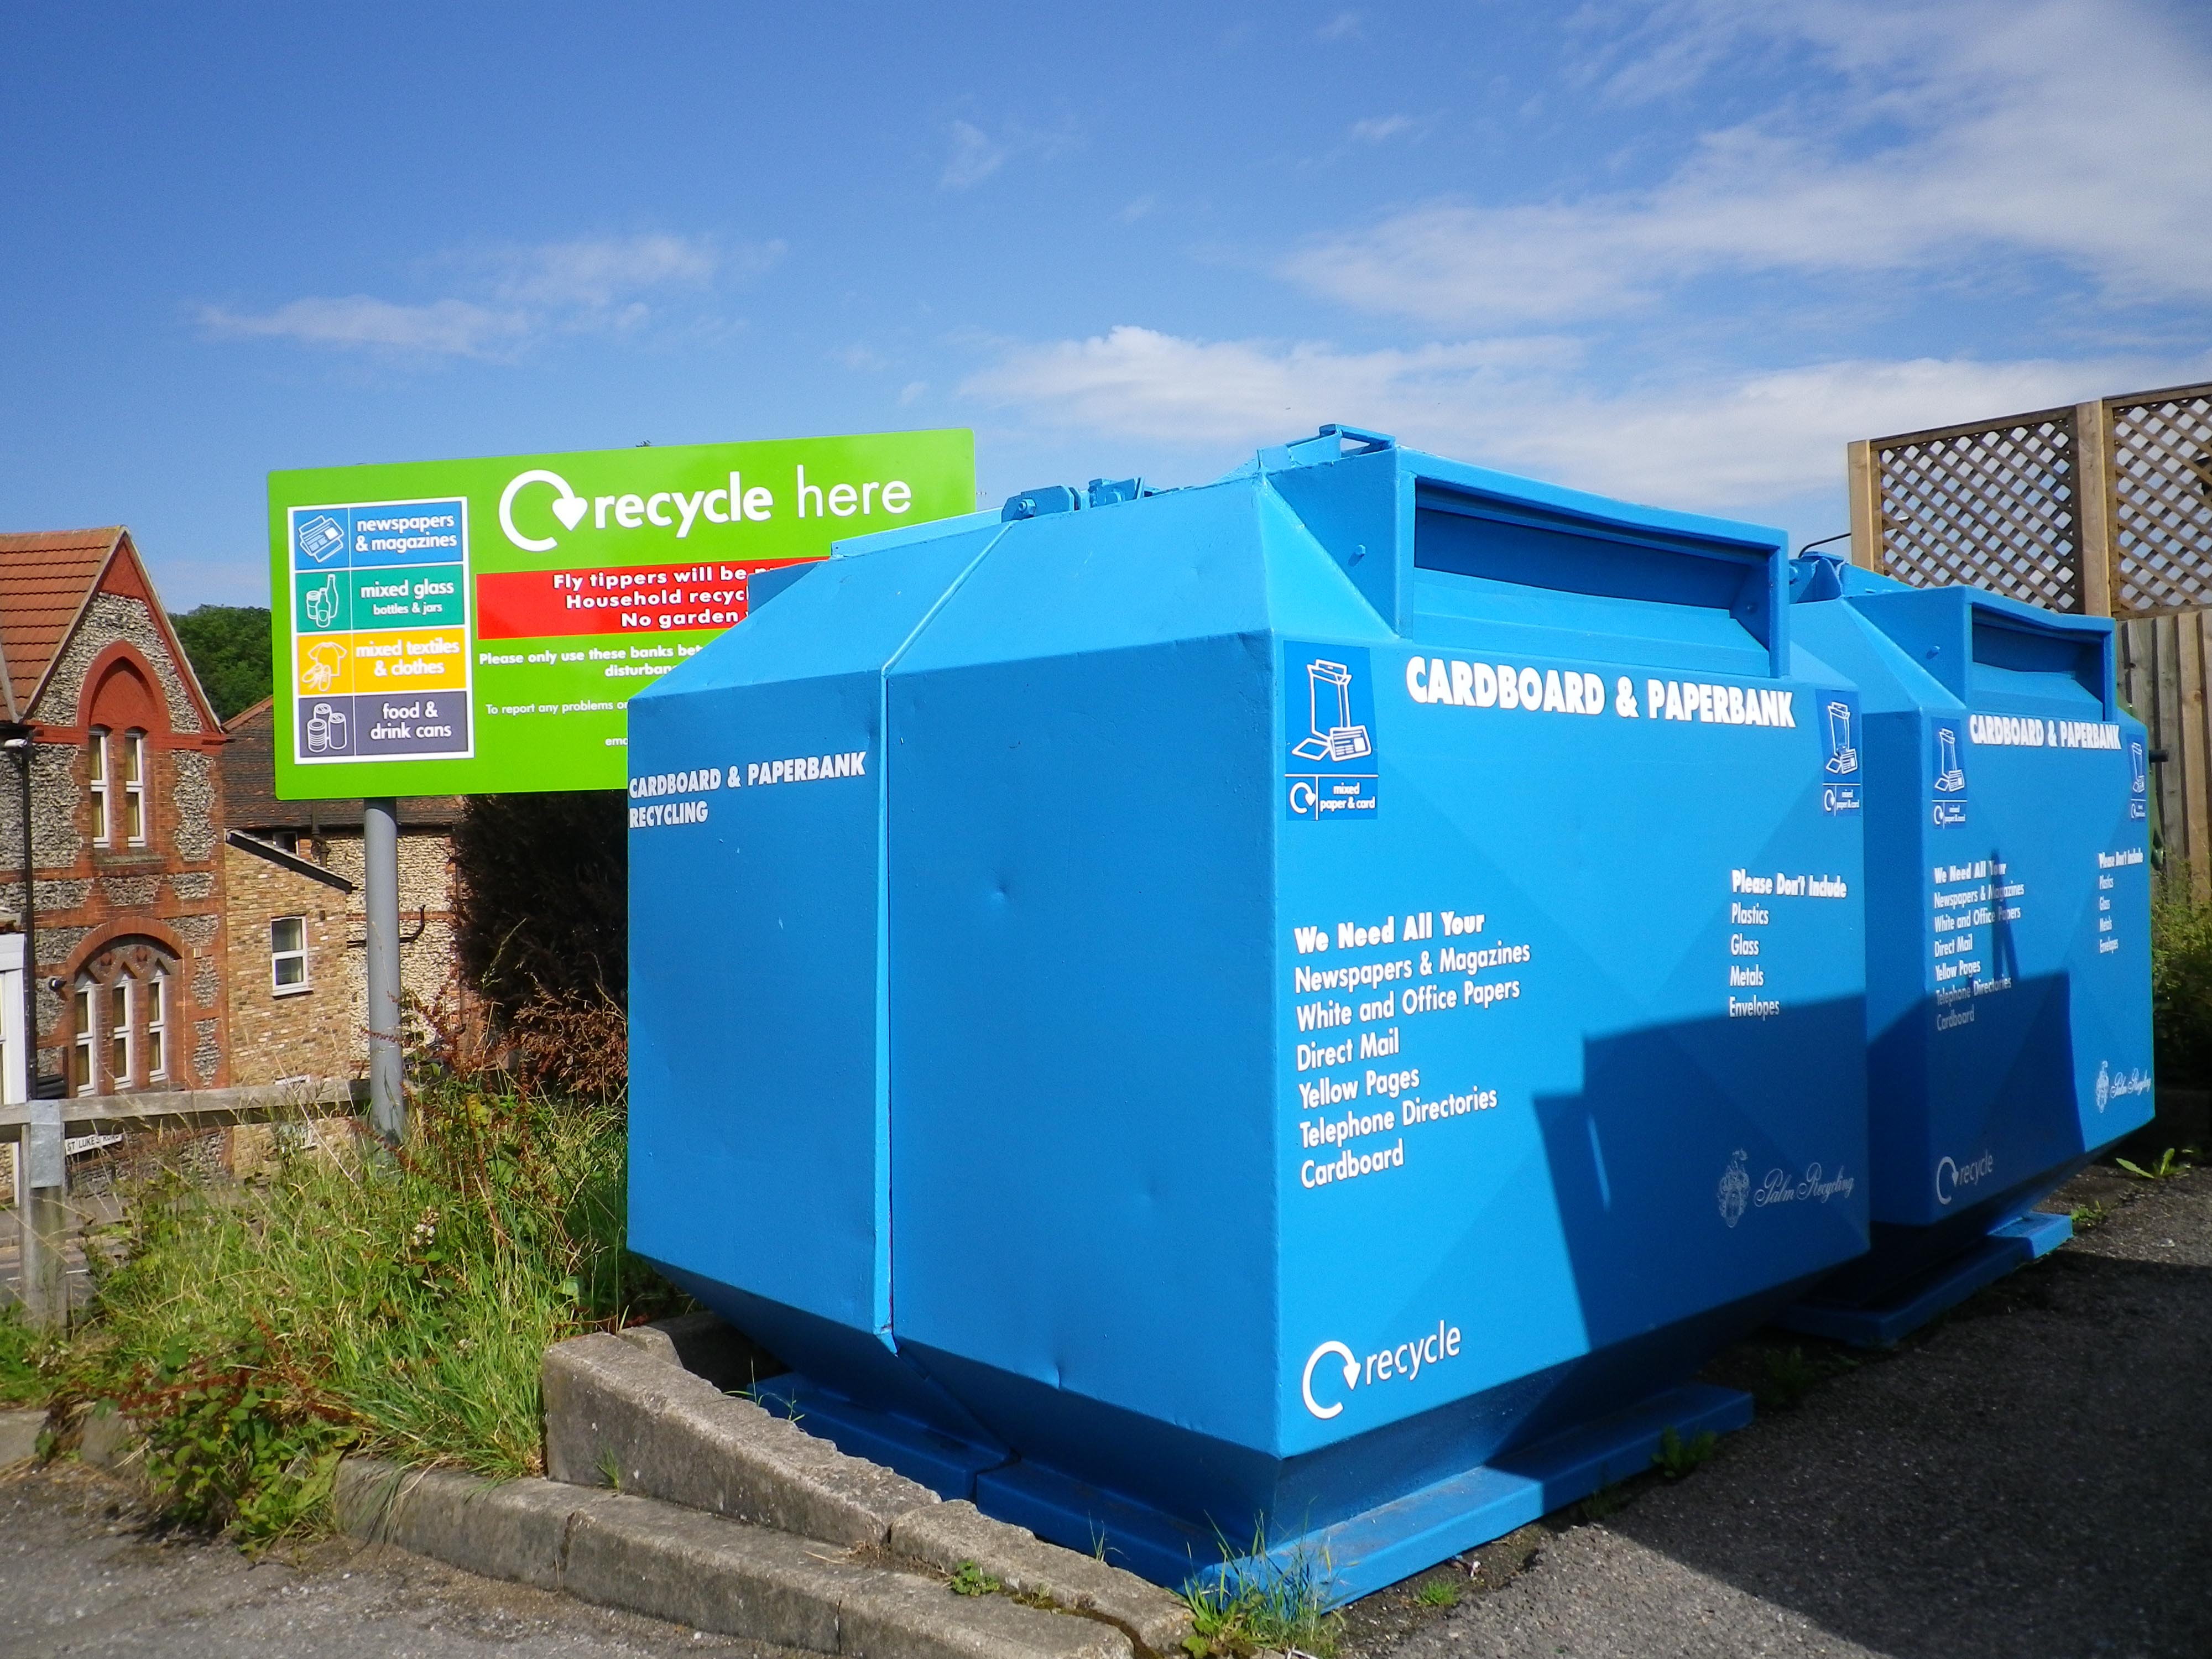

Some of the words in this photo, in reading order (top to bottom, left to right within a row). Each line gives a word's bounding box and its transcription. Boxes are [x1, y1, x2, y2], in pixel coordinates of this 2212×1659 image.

[594, 471, 774, 539] recycle
[796, 464, 912, 518] here
[357, 515, 455, 534] newspapers
[355, 535, 369, 552] &
[372, 531, 457, 554] magazines
[361, 579, 409, 598] mixed
[414, 578, 455, 599] glass
[553, 573, 583, 592] Fly
[589, 570, 667, 589] tippers
[673, 566, 712, 583] will
[720, 565, 747, 581] be
[373, 603, 409, 615] bottles
[411, 602, 421, 613] &
[422, 602, 443, 615] jars
[566, 589, 681, 609] Household
[621, 613, 651, 628] No
[658, 608, 739, 629] garden
[356, 639, 403, 658] mixed
[406, 637, 460, 655] textiles
[479, 653, 524, 665] Please
[528, 650, 557, 665] only
[561, 651, 585, 661] use
[589, 648, 626, 661] these
[630, 645, 674, 659] banks
[374, 660, 388, 676] &
[391, 658, 445, 676] clothes
[605, 663, 677, 677] disturban
[1406, 656, 1605, 715] CARDBOARD
[1615, 676, 1640, 718] &
[1647, 679, 1797, 728] PAPERBANK
[382, 701, 420, 719] food
[425, 701, 439, 718] &
[486, 704, 498, 715] To
[502, 703, 535, 716] report
[539, 704, 559, 716] any
[562, 700, 613, 714] problems
[371, 722, 411, 740] drink
[416, 724, 452, 738] cans
[1969, 714, 2044, 747] CARDBOARD
[2048, 719, 2058, 747] &
[2059, 721, 2122, 750] PAPERBANK
[629, 768, 721, 799] CARDBOARD
[727, 765, 742, 788] &
[748, 752, 867, 786] PAPERBANK
[1333, 781, 1360, 795] mixed
[629, 800, 708, 828] RECYCLING
[1319, 800, 1347, 812] paper
[1347, 796, 1355, 809] &
[1356, 796, 1376, 809] card
[1731, 868, 1773, 895] Please
[1776, 872, 1806, 896] Don't
[1808, 874, 1848, 899] Include
[1934, 867, 1947, 884] We
[1949, 862, 1971, 882] Need
[1974, 860, 1986, 879] All
[1988, 860, 2007, 875] Your
[1934, 890, 1979, 910] Newspapers
[1980, 885, 1986, 901] &
[1988, 880, 2025, 902] Magazines
[1731, 901, 1769, 925] Plastics
[1934, 914, 1955, 933] White
[1957, 910, 1971, 929] and
[1973, 907, 1996, 926] Office
[1293, 926, 1329, 954] We
[1337, 916, 1395, 950] Need
[1403, 911, 1433, 941] All
[1441, 911, 1485, 937] Your
[1730, 932, 1760, 956] Glass
[1934, 939, 1955, 958] Direct
[1957, 933, 1973, 953] Mail
[1295, 958, 1413, 994] Newspapers
[1420, 950, 1433, 977] &
[1439, 940, 1531, 976] Magazines
[1730, 964, 1764, 987] Metals
[1935, 962, 1958, 982] Yellow
[1959, 959, 1981, 978] Pages
[1936, 984, 1971, 1007] Telephone
[1973, 974, 2012, 996] Directories
[1296, 1000, 1352, 1032] White
[1359, 990, 1395, 1022] and
[1402, 984, 1458, 1015] Office
[1464, 980, 1520, 1009] Papers
[1729, 994, 1780, 1021] Envelopes
[1937, 1004, 1975, 1031] Cardboard
[1297, 1039, 1353, 1072] Direct
[1360, 1026, 1400, 1060] Mail
[1298, 1077, 1359, 1110] Yellow
[1365, 1068, 1420, 1099] Pages
[1300, 1110, 1395, 1149] Telephone
[1402, 1085, 1498, 1126] Directories
[67, 1141, 75, 1151] ST
[1301, 1138, 1404, 1189] Cardboard
[1960, 1149, 1993, 1186] recycle
[1365, 1319, 1462, 1386] recycle
